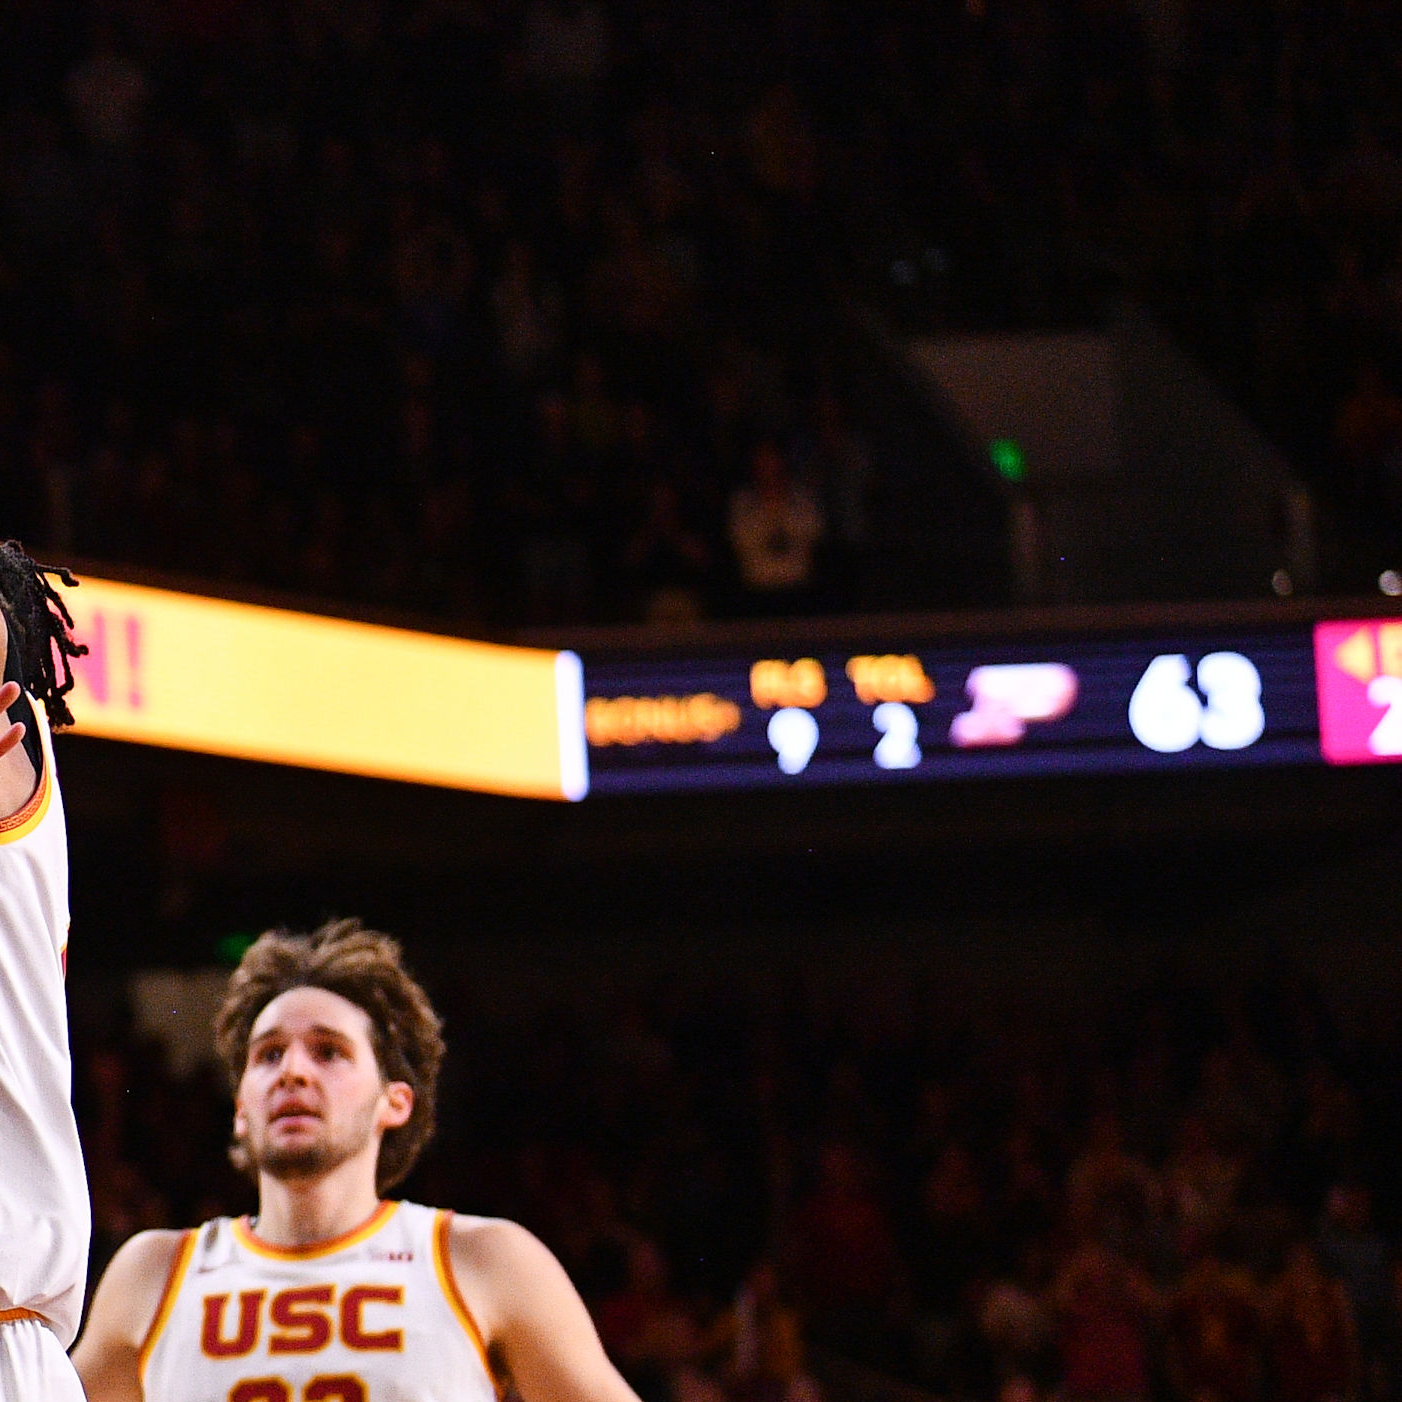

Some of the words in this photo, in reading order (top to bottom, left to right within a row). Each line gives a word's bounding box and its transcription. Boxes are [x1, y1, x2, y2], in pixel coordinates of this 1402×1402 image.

[873, 702, 922, 769] 2
[1129, 652, 1265, 752] 63
[768, 707, 819, 774] 9
[200, 1283, 406, 1360] USC
